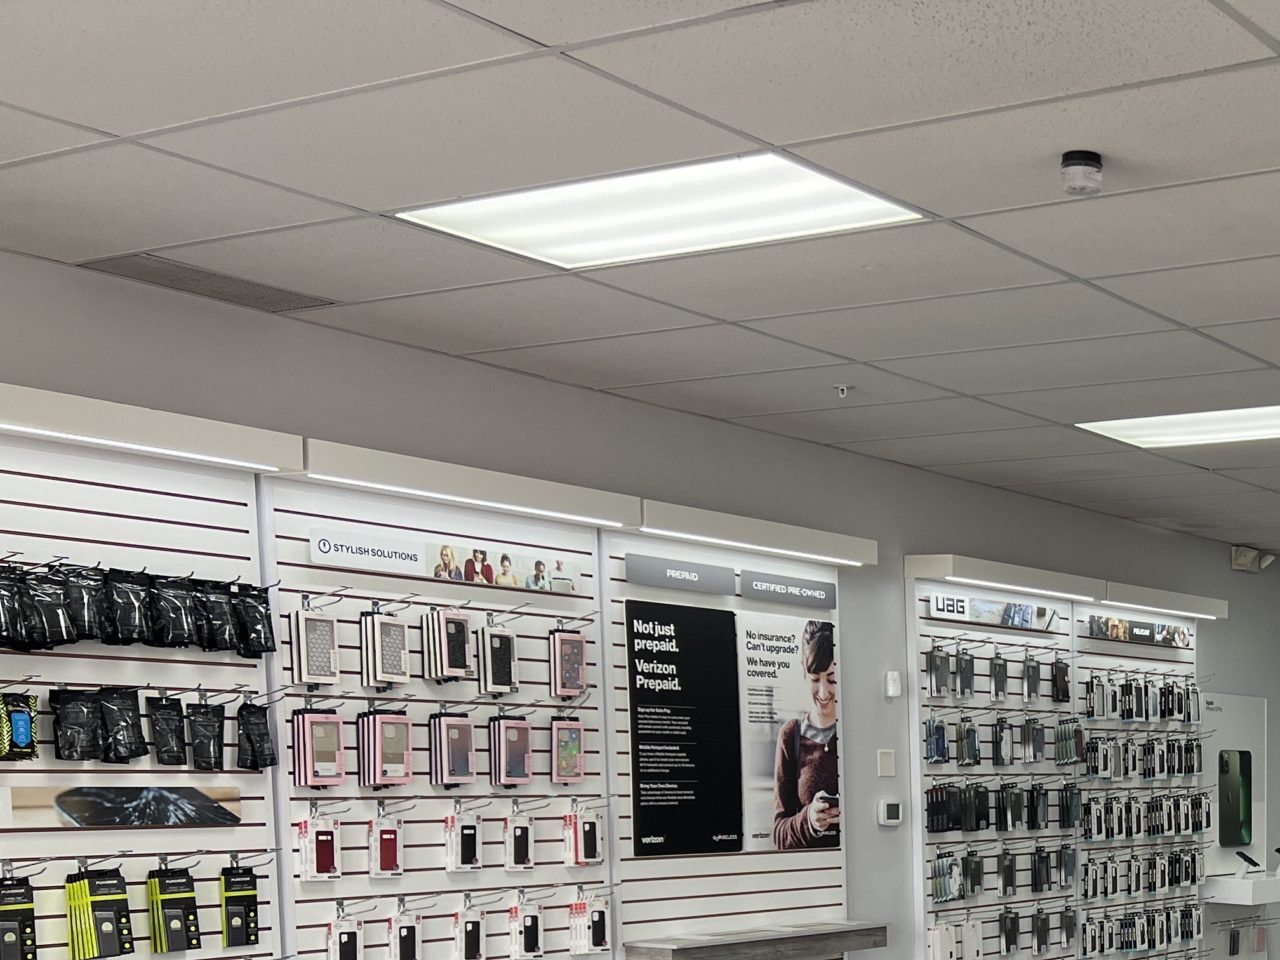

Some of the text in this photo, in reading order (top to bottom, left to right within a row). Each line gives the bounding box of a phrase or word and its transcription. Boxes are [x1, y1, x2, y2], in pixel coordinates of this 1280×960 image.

[333, 543, 418, 562] STYLISH SOLUTIONS
[666, 568, 699, 582] PREPAID
[752, 581, 826, 599] CERTIFIED PRE-OWNED
[633, 619, 675, 637] Not just
[746, 630, 796, 644] No insurance?
[634, 638, 680, 654] prepaid.
[746, 641, 799, 655] Can't upgrade?
[634, 659, 677, 675] Verizon
[746, 657, 790, 670] We have you
[747, 669, 778, 679] covered.
[636, 675, 682, 692] Prepaid.
[641, 835, 664, 844] verizon
